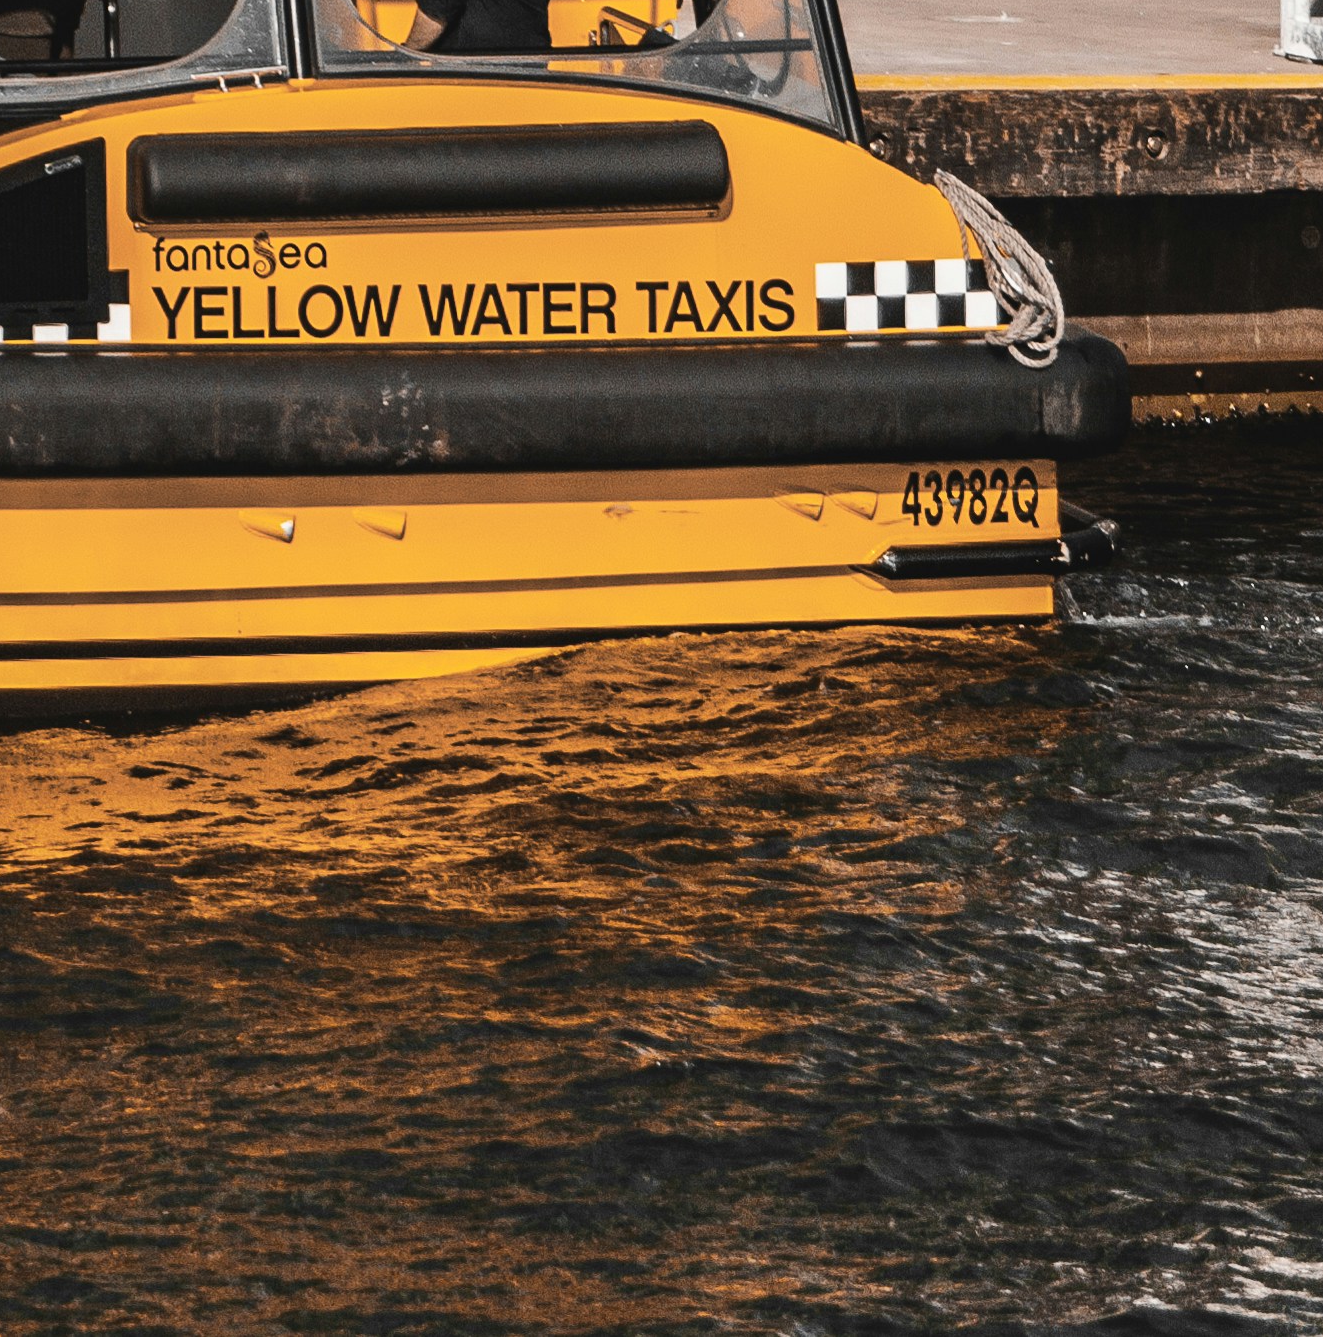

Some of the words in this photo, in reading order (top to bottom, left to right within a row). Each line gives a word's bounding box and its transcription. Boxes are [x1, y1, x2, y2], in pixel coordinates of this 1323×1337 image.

[152, 285, 402, 339] YELLOW
[418, 282, 618, 336] WATER
[635, 278, 796, 332] TAXIS
[902, 465, 1039, 528] 43982Q
